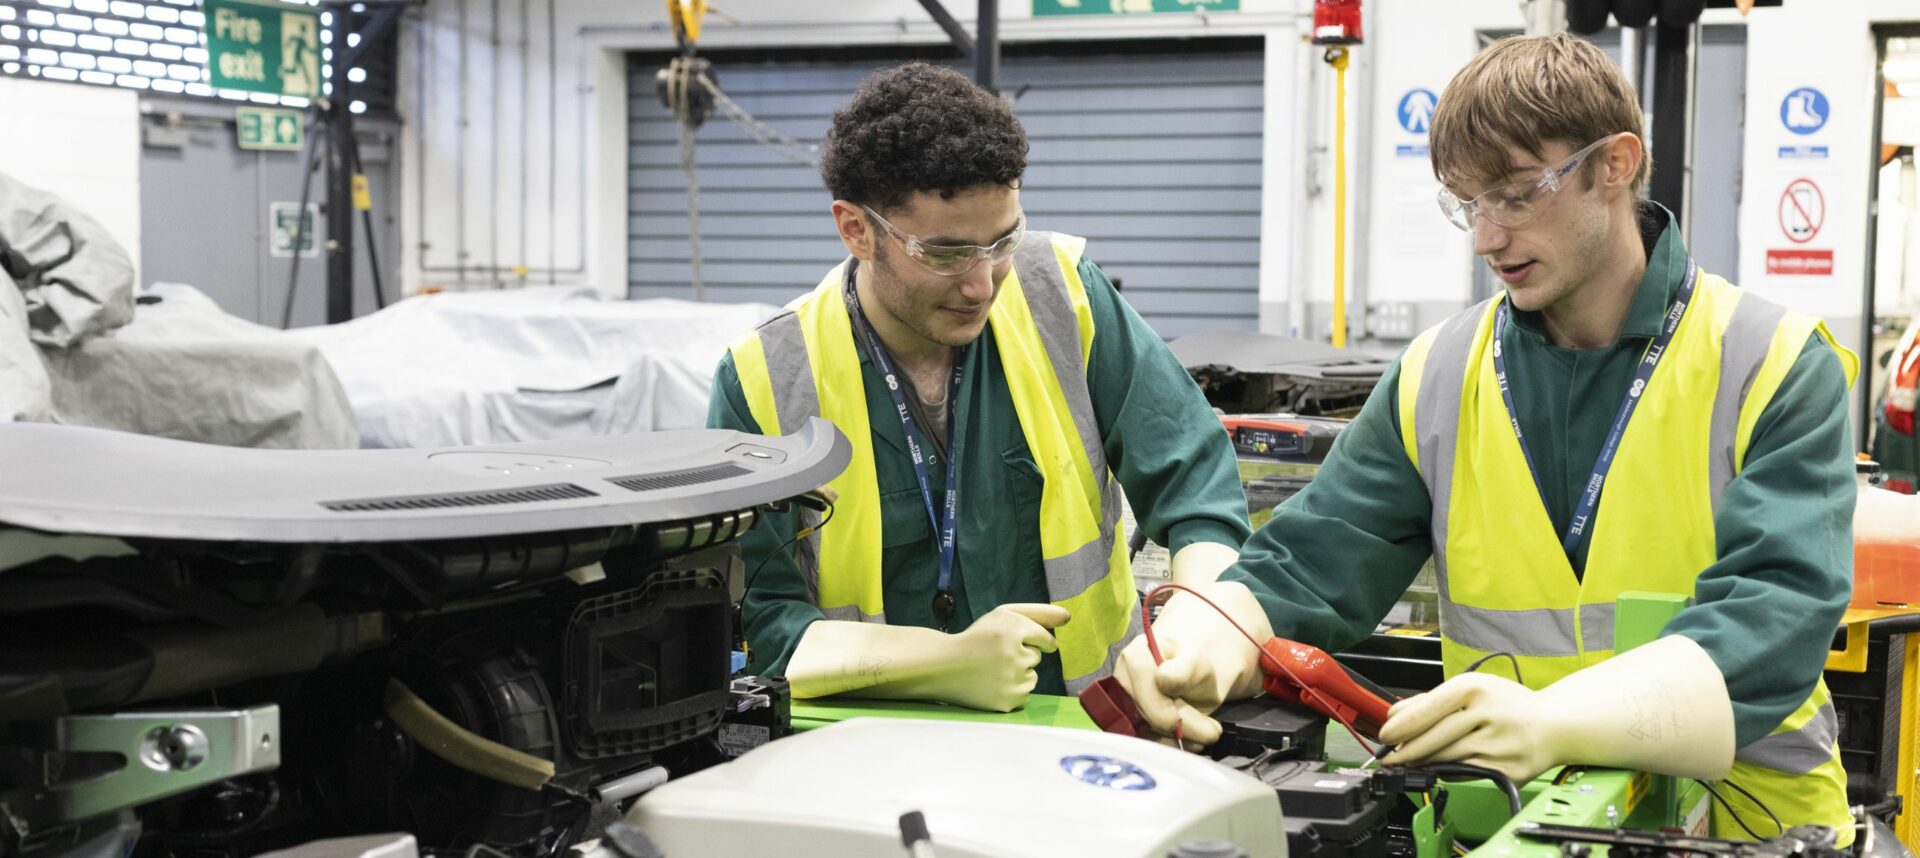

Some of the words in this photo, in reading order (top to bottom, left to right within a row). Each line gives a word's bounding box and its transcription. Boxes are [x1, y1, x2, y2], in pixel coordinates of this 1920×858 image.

[215, 7, 262, 44] Fire
[219, 48, 265, 82] exit
[1668, 303, 1686, 333] NORTHERN
[1669, 301, 1682, 320] SKILLS
[1645, 345, 1664, 366] TTE
[1497, 371, 1507, 393] TTE
[898, 403, 910, 424] TTE
[1512, 418, 1522, 438] SKILLS
[907, 436, 919, 465] NORTHERN
[915, 445, 923, 463] SKILLS
[1587, 473, 1599, 493] SKILLS
[1587, 475, 1604, 507] NORTHERN
[1571, 515, 1588, 535] TTE
[943, 528, 953, 548] TTE
